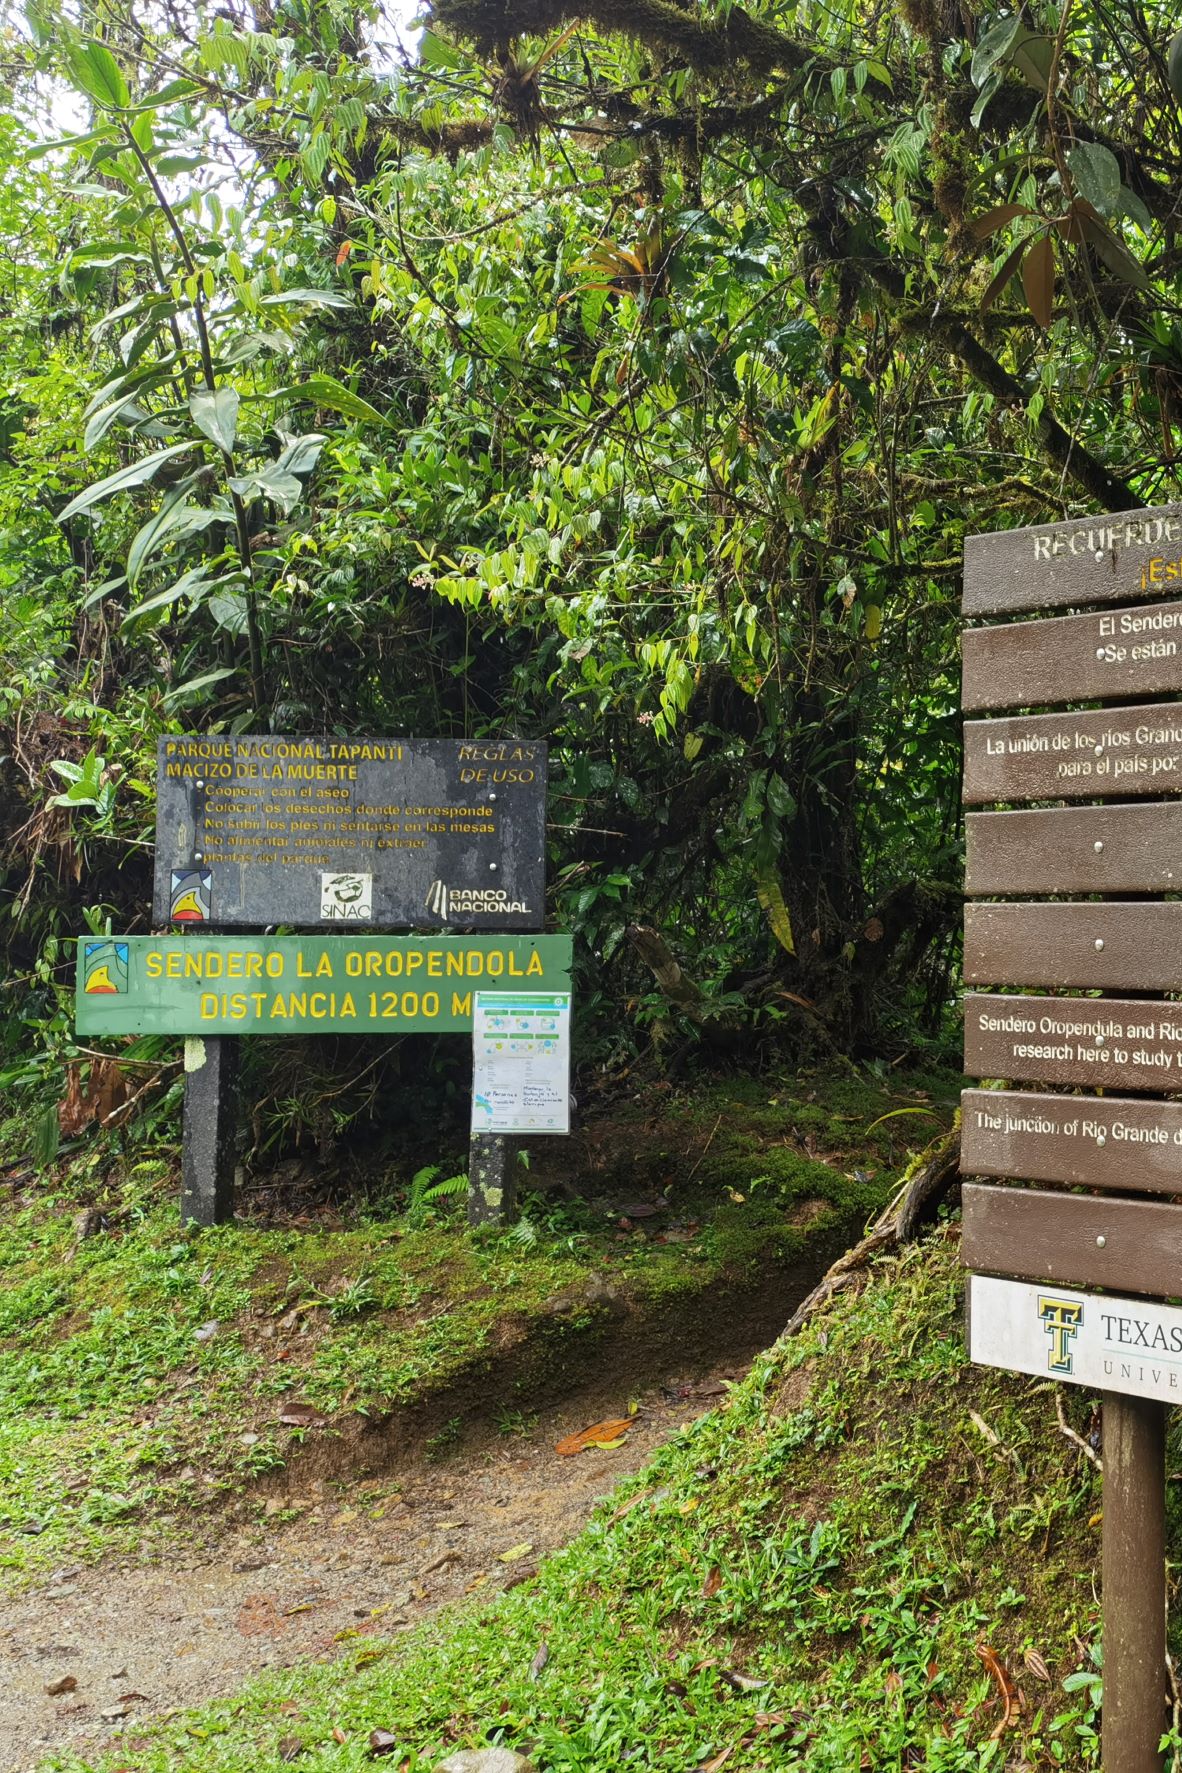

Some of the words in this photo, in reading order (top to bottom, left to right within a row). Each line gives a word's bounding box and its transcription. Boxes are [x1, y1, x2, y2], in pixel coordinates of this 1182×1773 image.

[1098, 615, 1115, 636] El
[166, 742, 233, 759] PARQUE
[237, 743, 325, 760] NACIONAL
[459, 746, 537, 761] REGLAS
[166, 762, 232, 778] MACIZO
[236, 763, 258, 778] DE
[262, 764, 283, 779] LA
[287, 764, 358, 780] MUERTE
[460, 768, 489, 783] DE
[492, 768, 535, 783] USO
[205, 784, 265, 798] Cooperar
[271, 788, 296, 797] con
[300, 786, 312, 798] el
[316, 788, 350, 798] aseo
[205, 801, 257, 813] Colocar
[286, 803, 352, 815] desechos
[356, 804, 400, 816] donde
[405, 805, 493, 819] corresponde
[205, 818, 224, 829] No
[267, 819, 286, 830] los
[290, 820, 319, 833] pies
[340, 822, 400, 832] sentarse
[405, 822, 422, 832] en
[426, 821, 446, 833] las
[450, 823, 495, 833] mesas
[205, 835, 223, 846] No
[450, 889, 507, 900] BANCO
[321, 903, 371, 918] SINAC
[449, 901, 532, 914] NACIONAL
[145, 951, 284, 978] SENDERO
[296, 951, 333, 978] LA
[345, 950, 544, 977] OROPENDOLA
[200, 991, 357, 1020] DISTANCIA
[368, 991, 440, 1018] 1200
[978, 1014, 1036, 1033] Sendero
[1038, 1016, 1122, 1039] Oropendula
[1125, 1021, 1154, 1039] and
